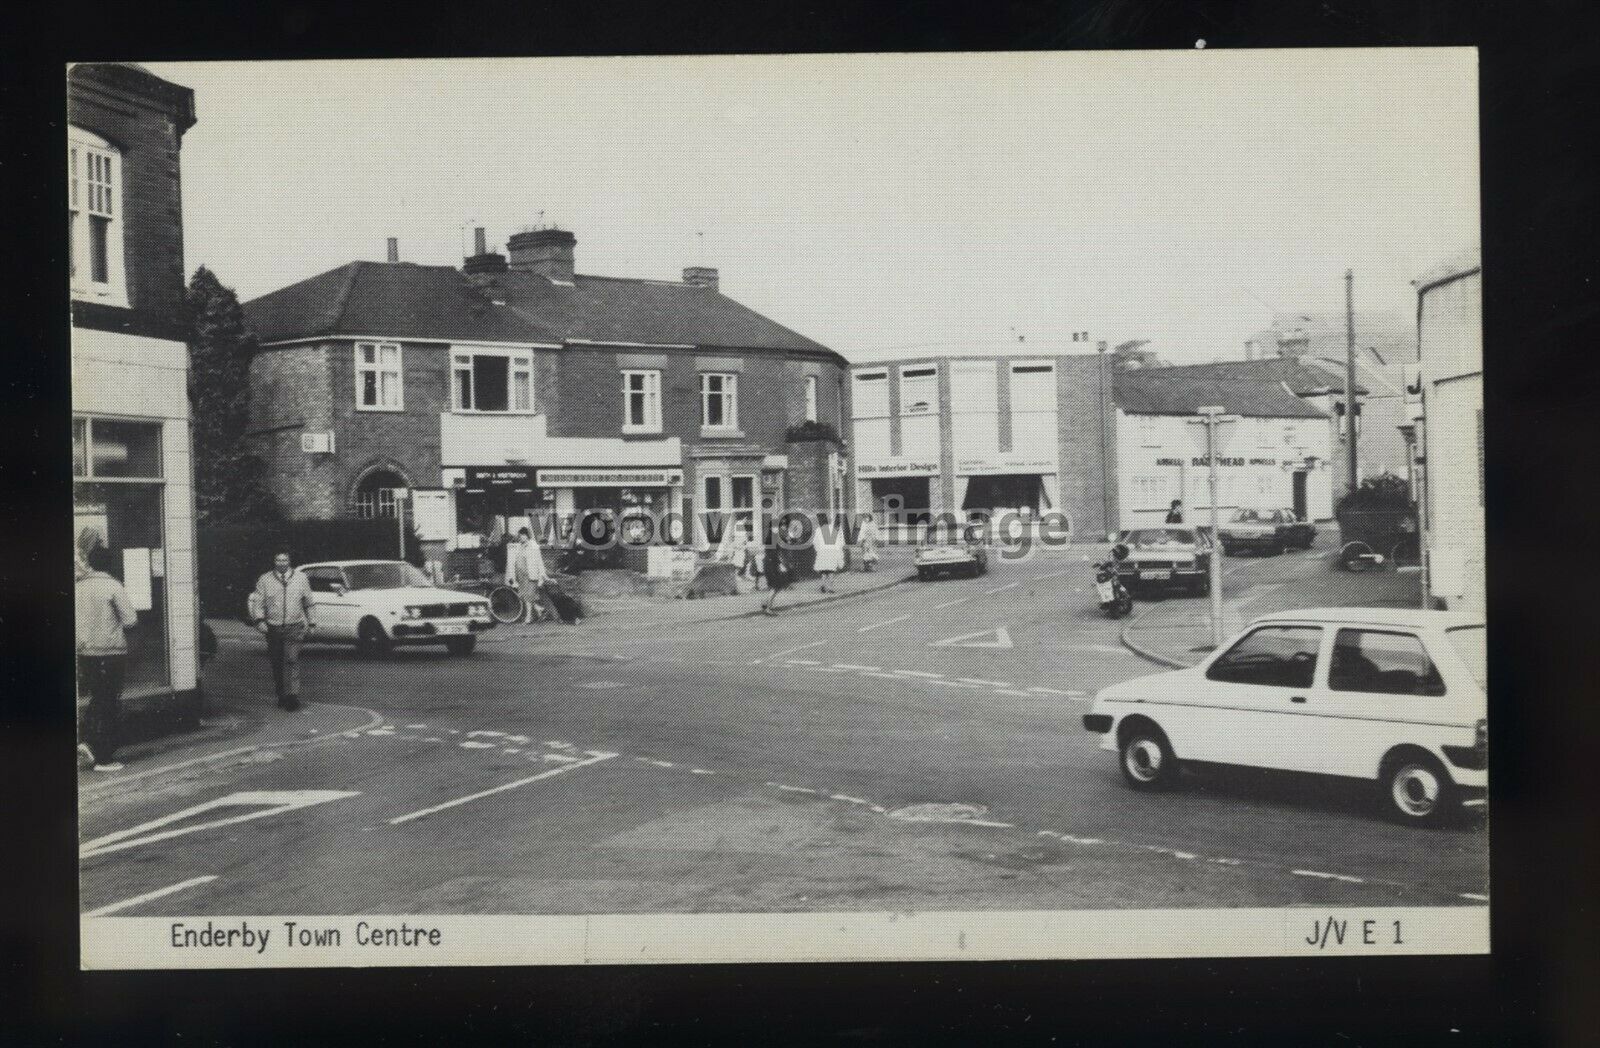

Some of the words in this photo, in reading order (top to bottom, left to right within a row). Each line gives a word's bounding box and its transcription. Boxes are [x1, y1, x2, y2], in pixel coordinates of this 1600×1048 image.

[879, 464, 908, 472] Interior
[910, 462, 938, 471] Design
[1219, 457, 1245, 467] HEAD
